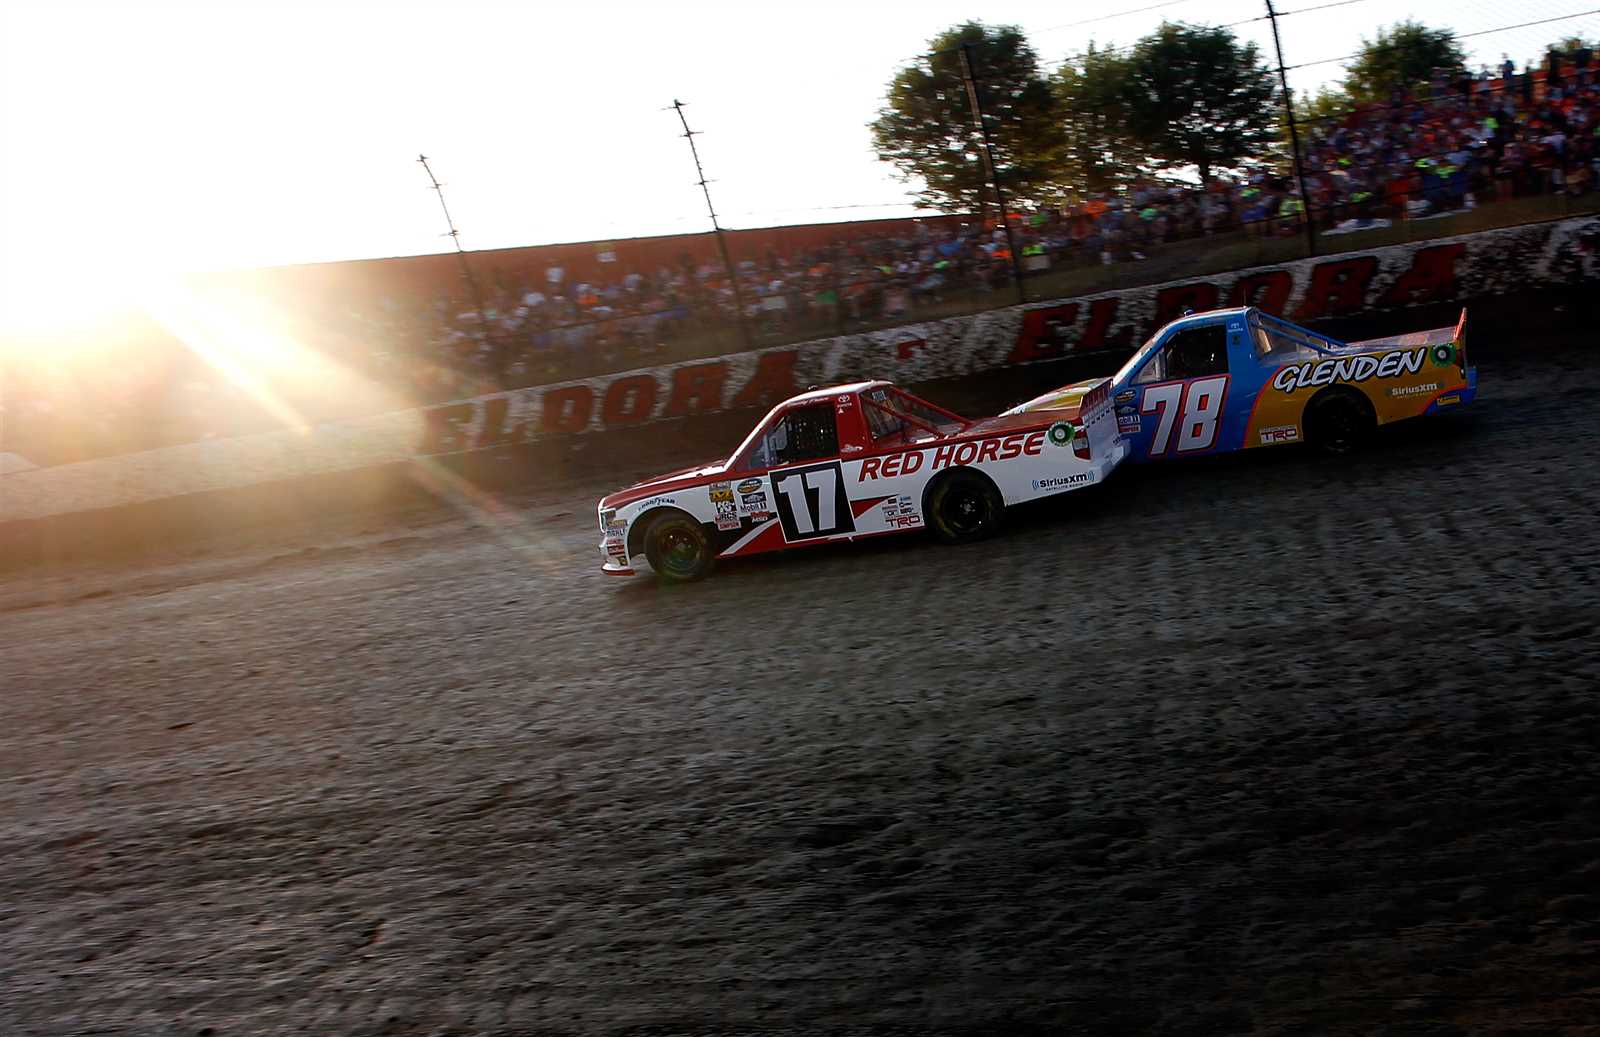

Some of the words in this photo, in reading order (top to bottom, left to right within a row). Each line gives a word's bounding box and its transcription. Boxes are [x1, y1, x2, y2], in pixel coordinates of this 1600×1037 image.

[1272, 346, 1427, 393] GLENDEN
[426, 352, 797, 452] ELDORA
[1140, 375, 1229, 457] 78
[858, 450, 924, 482] RED
[931, 430, 1047, 470] HORSE
[1260, 428, 1297, 441] TRD
[740, 502, 760, 512] Mobil
[777, 467, 837, 535] 17
[885, 515, 920, 528] TRD
